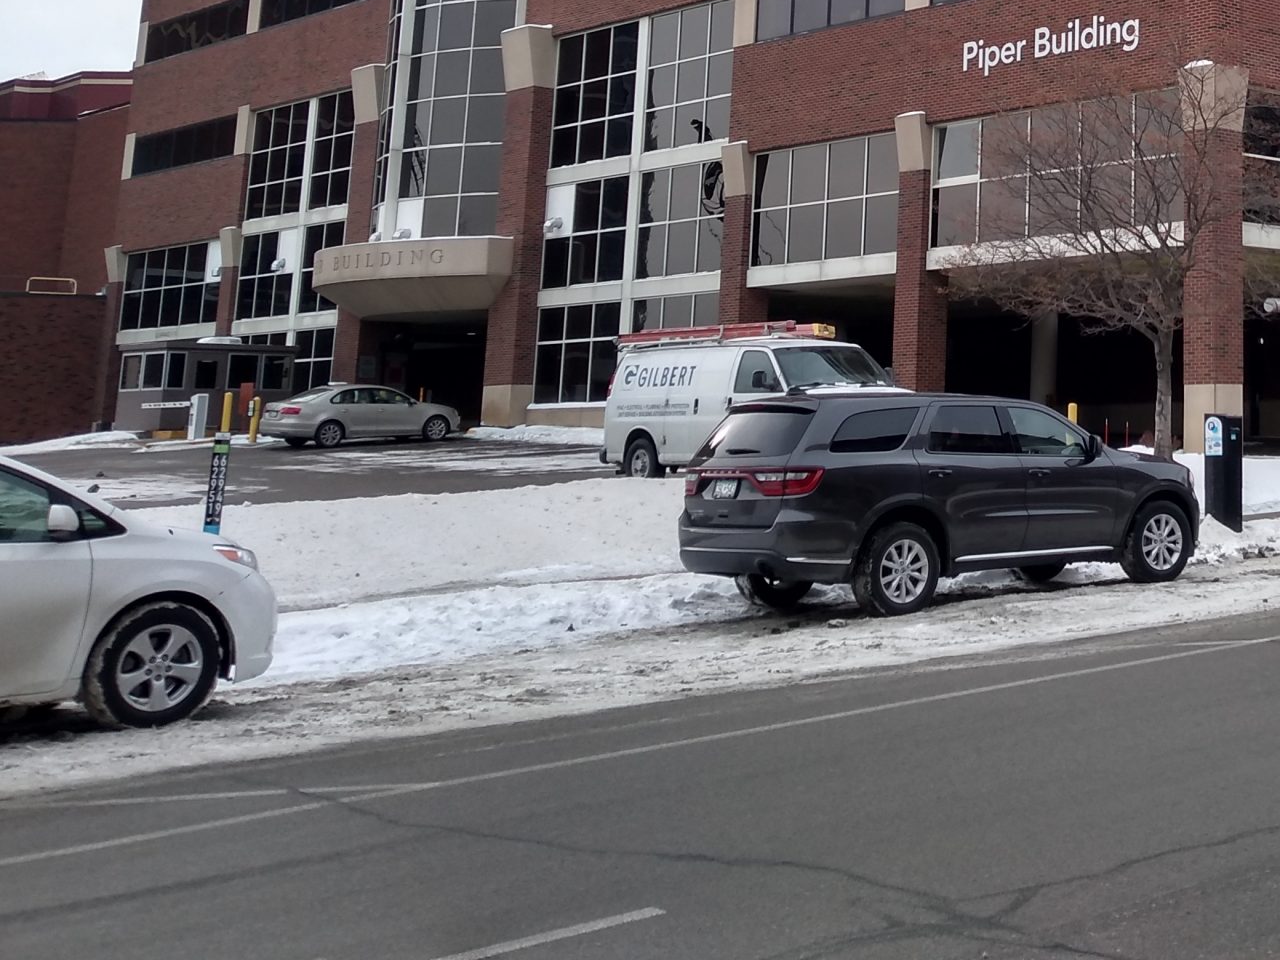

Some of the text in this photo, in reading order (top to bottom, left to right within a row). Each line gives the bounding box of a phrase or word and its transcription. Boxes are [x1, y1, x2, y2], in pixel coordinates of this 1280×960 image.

[962, 15, 1140, 77] Piper Building
[333, 249, 444, 272] BUILDING
[638, 365, 697, 388] GILBERT
